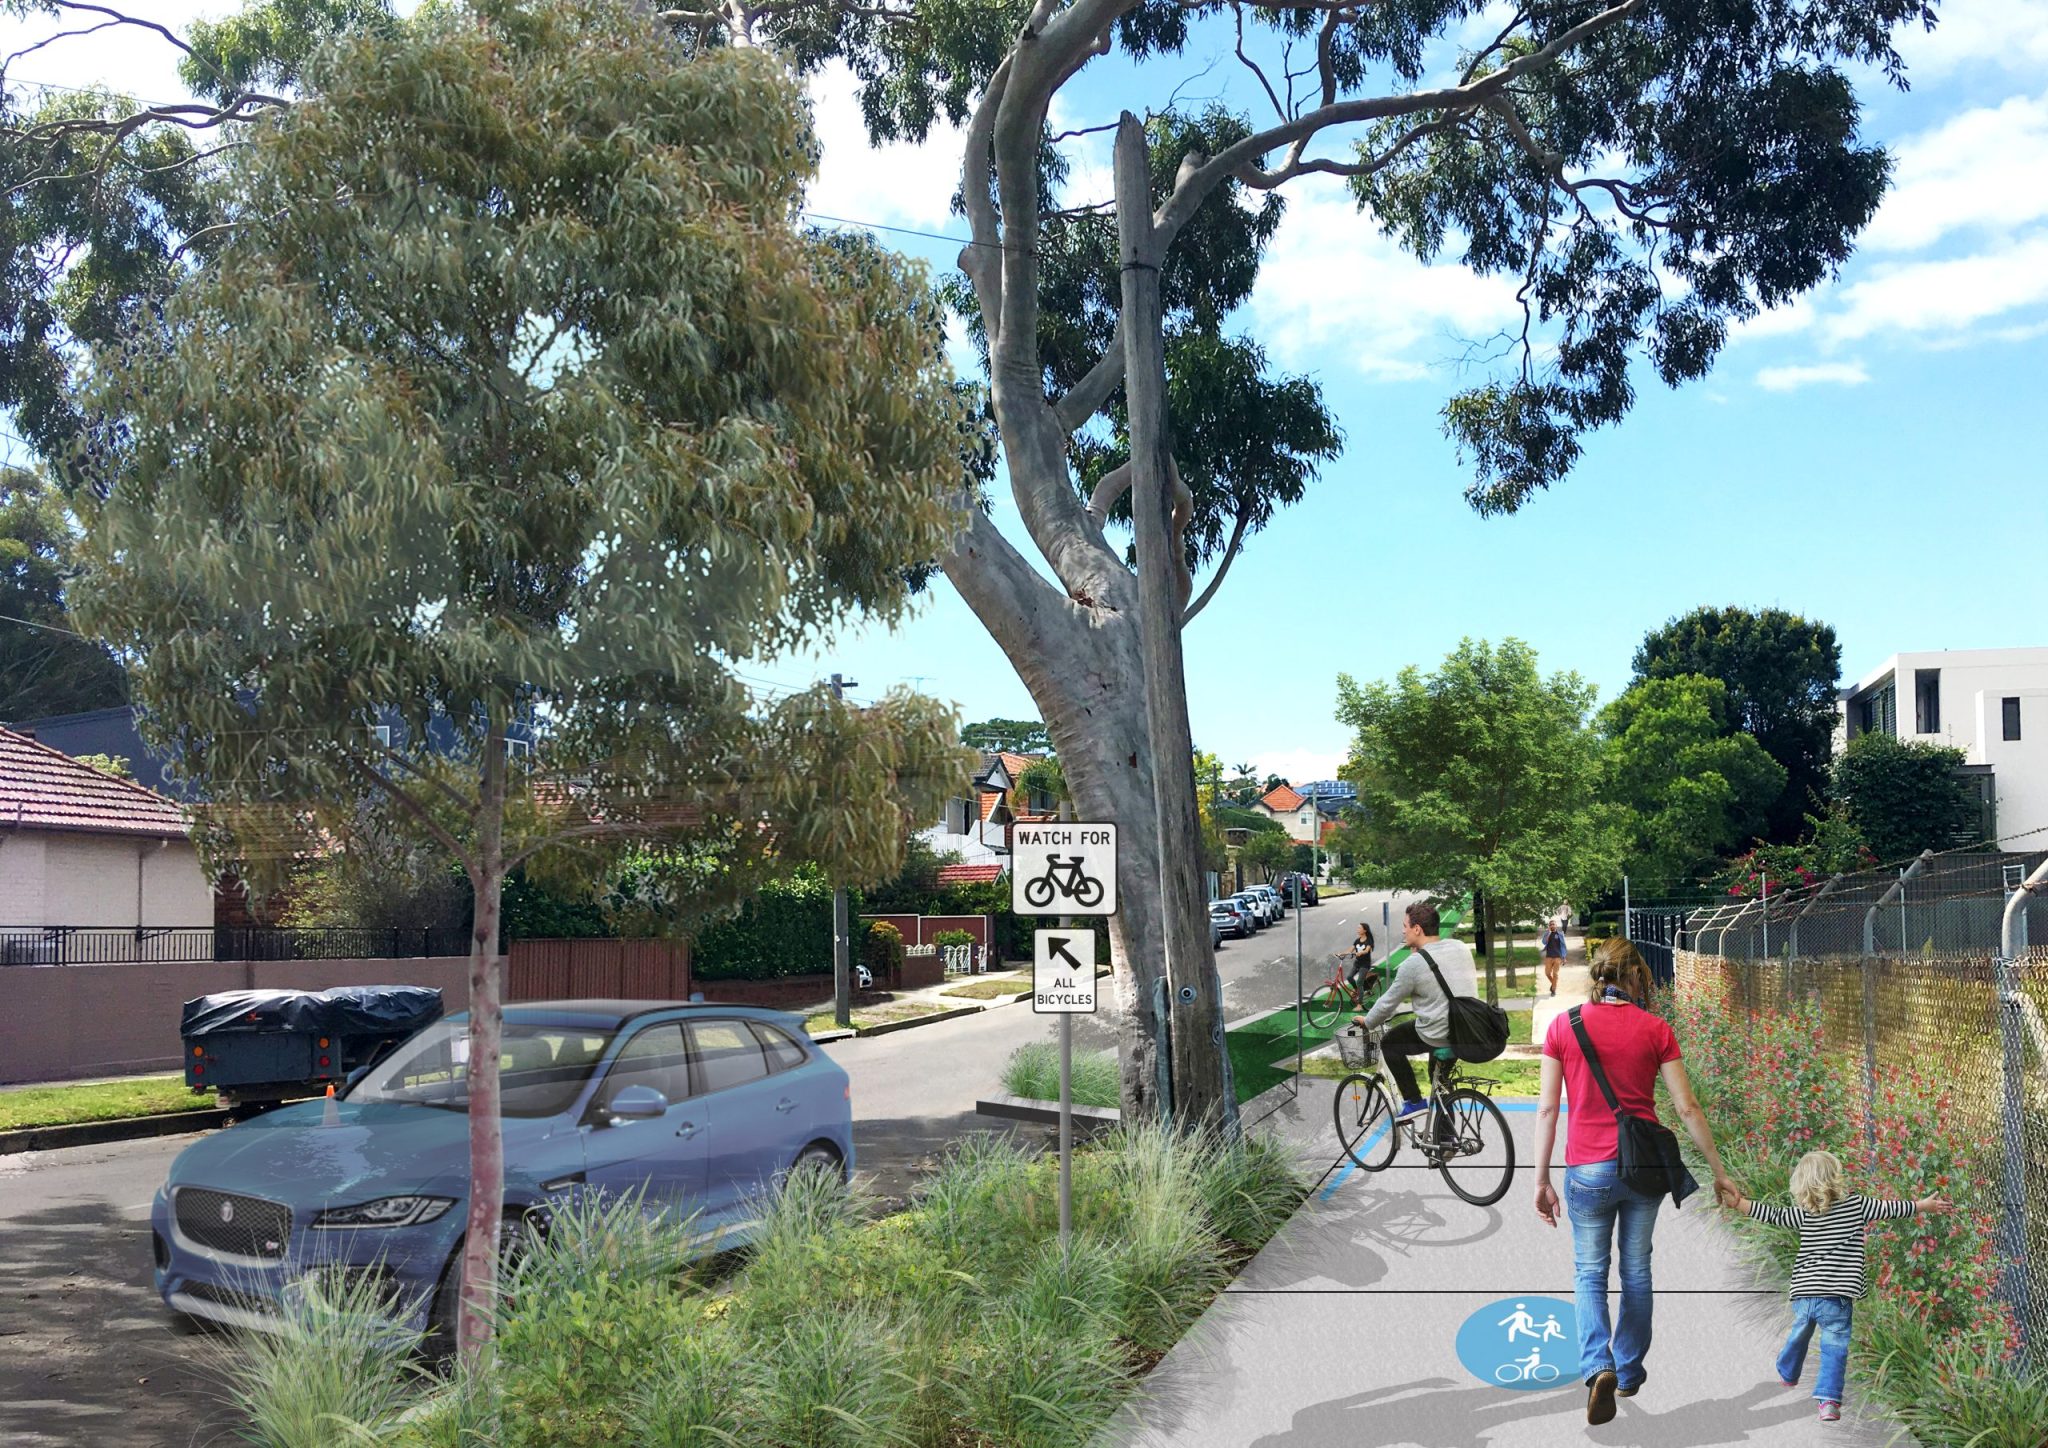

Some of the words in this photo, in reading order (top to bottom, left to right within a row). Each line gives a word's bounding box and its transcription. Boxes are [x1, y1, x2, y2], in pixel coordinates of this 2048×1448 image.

[1018, 831, 1072, 845] WATCH
[1081, 831, 1110, 845] FOR
[1054, 978, 1076, 988] ALL
[1037, 994, 1092, 1005] BICYCLES
